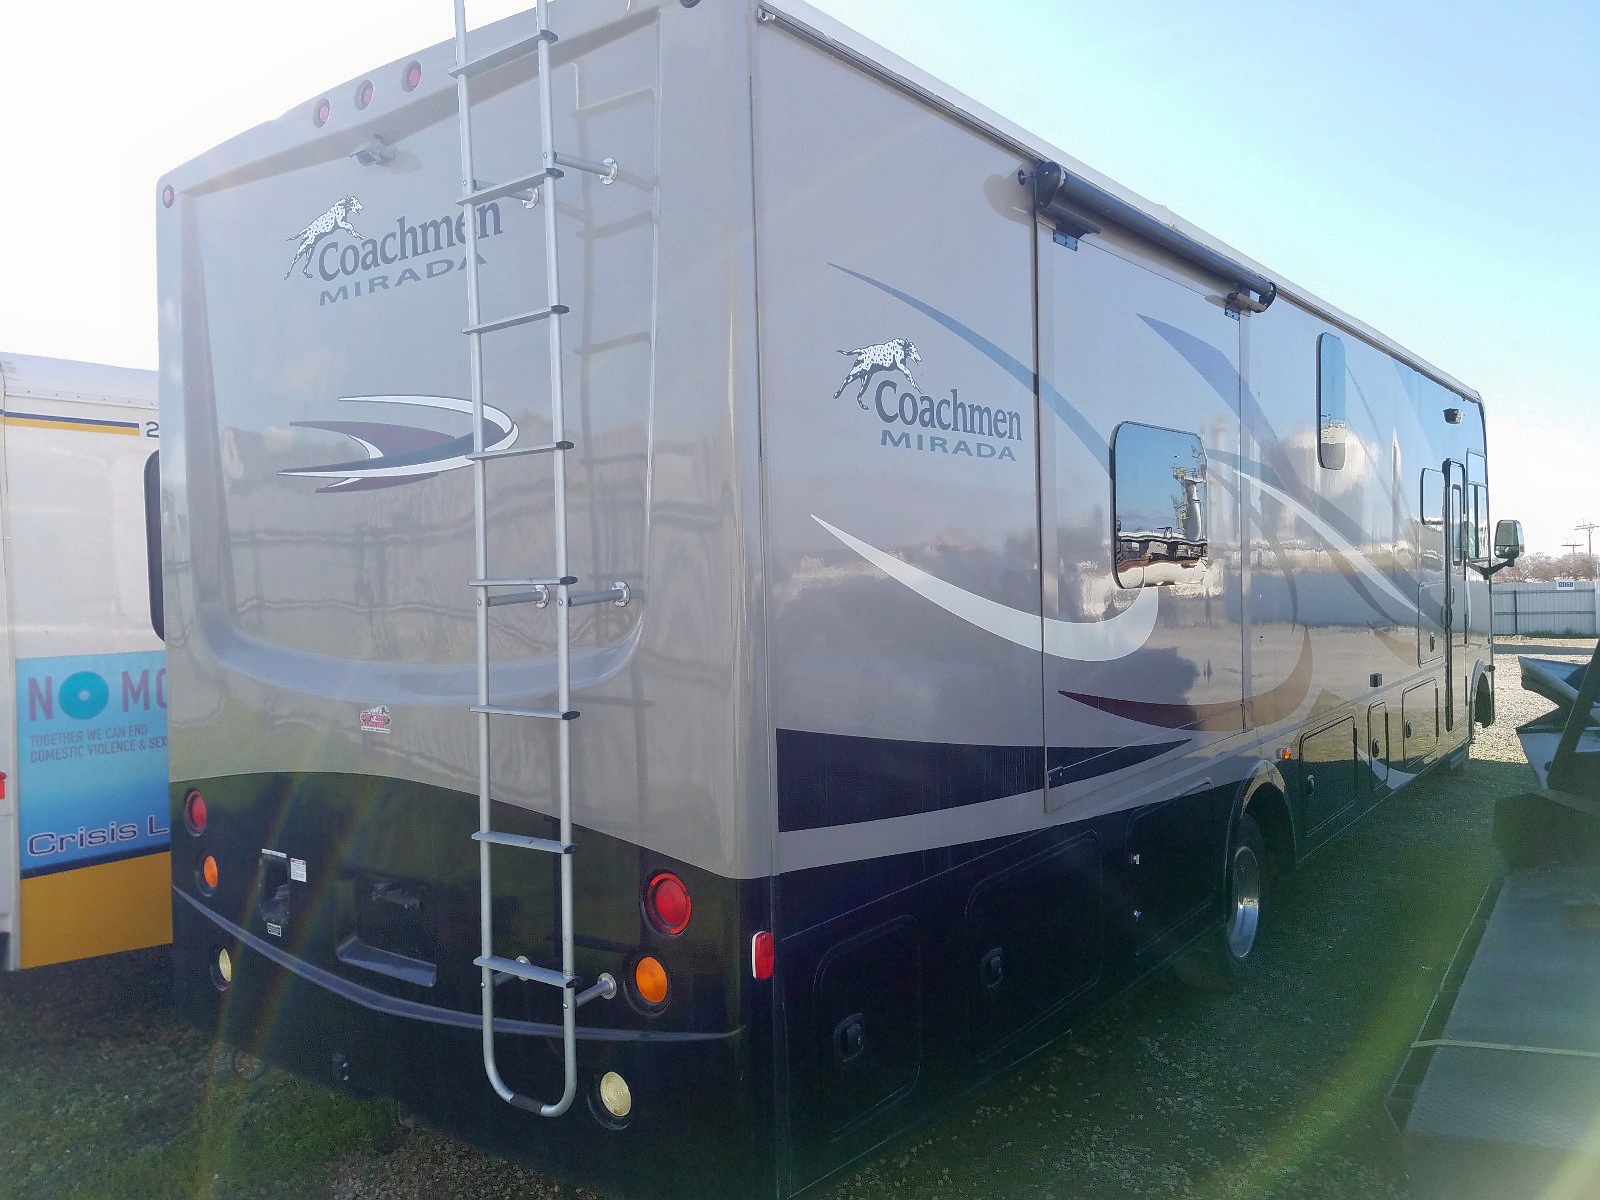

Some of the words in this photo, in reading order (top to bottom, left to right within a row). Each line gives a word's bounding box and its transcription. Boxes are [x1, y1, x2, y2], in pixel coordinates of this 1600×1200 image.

[318, 202, 503, 281] Coachmen
[320, 253, 488, 306] MIRADA
[875, 379, 1022, 441] Coachmen
[880, 429, 1017, 461] MIRADA
[30, 729, 83, 748] TOGETHER
[87, 728, 103, 741] WE
[105, 725, 126, 740] CAN
[128, 723, 148, 737] END
[30, 743, 84, 764] DOMESTIC
[87, 737, 136, 757] VIOLENCE
[138, 738, 146, 751] &
[27, 820, 138, 857] Crisis
[146, 814, 169, 837] L
